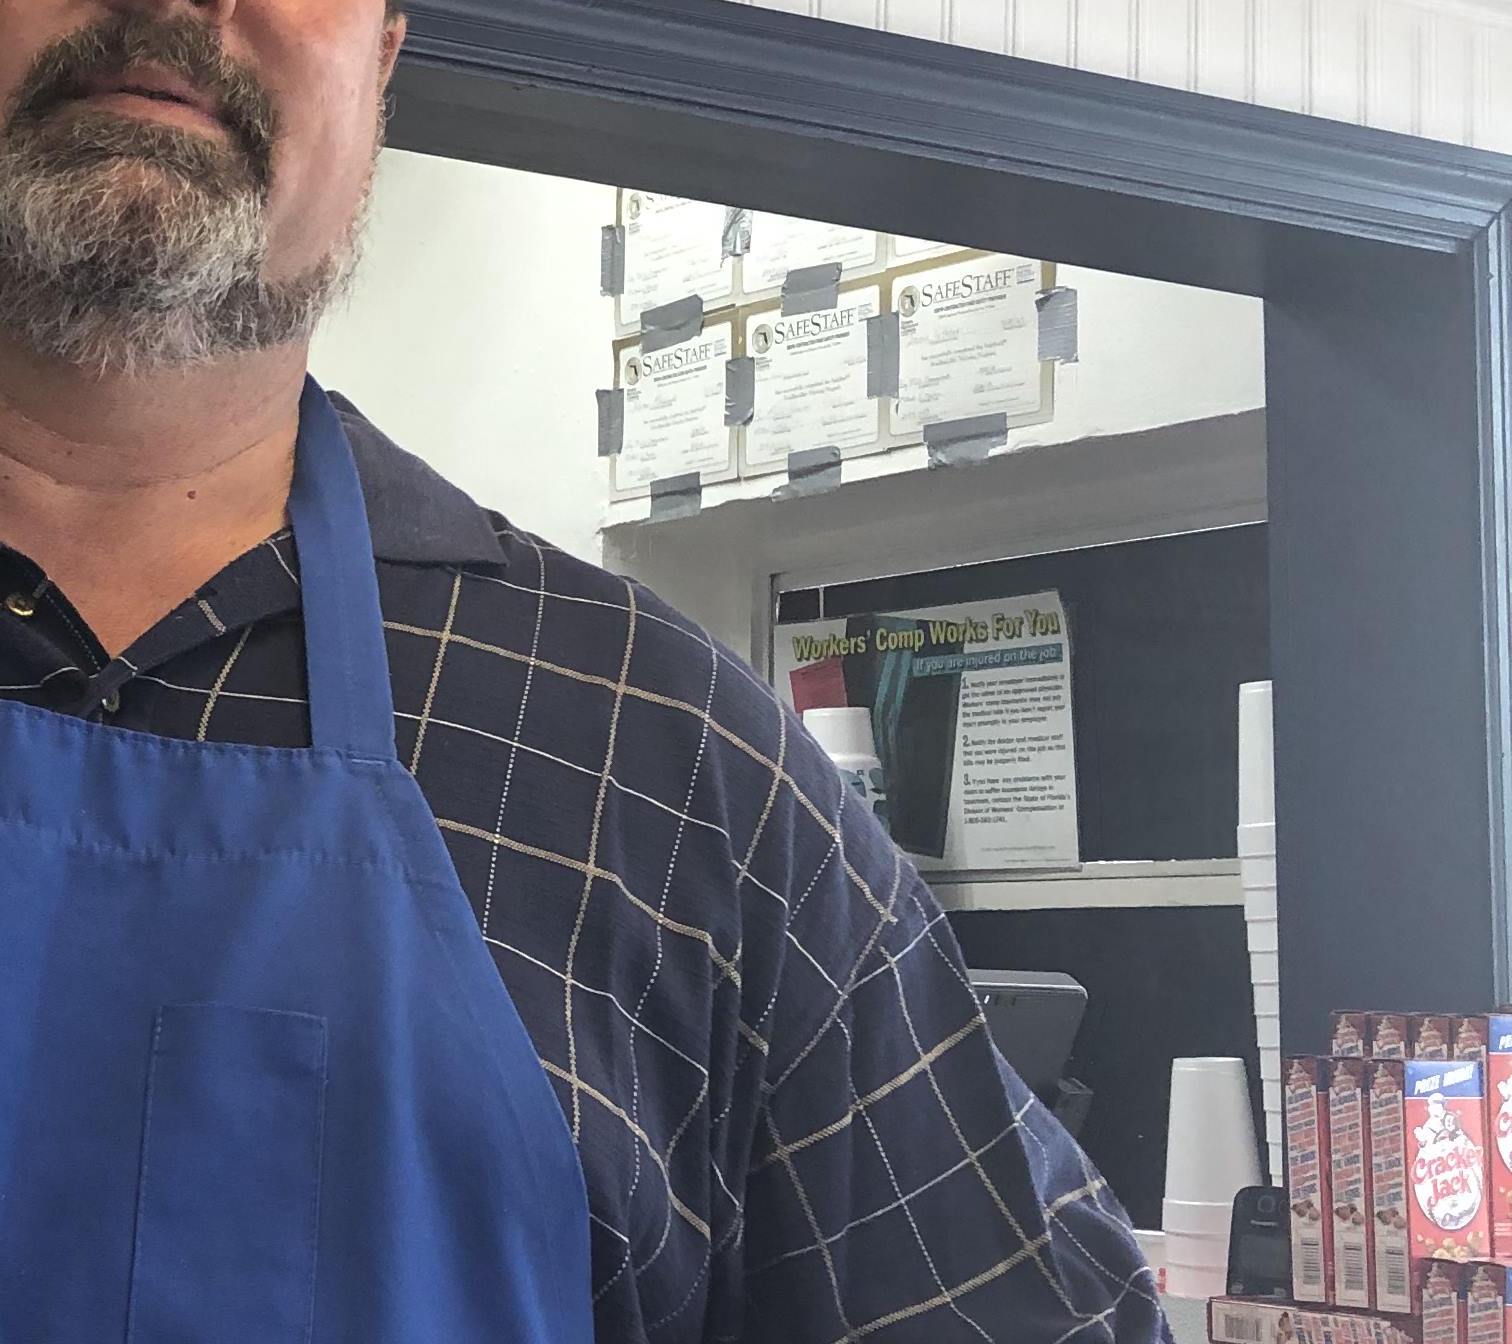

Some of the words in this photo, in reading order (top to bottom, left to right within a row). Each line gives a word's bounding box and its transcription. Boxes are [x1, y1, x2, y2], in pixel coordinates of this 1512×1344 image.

[876, 624, 925, 654] Comp
[929, 617, 988, 647] Works
[991, 613, 1023, 641] For
[1024, 608, 1062, 636] You
[1427, 1170, 1473, 1208] Jack
